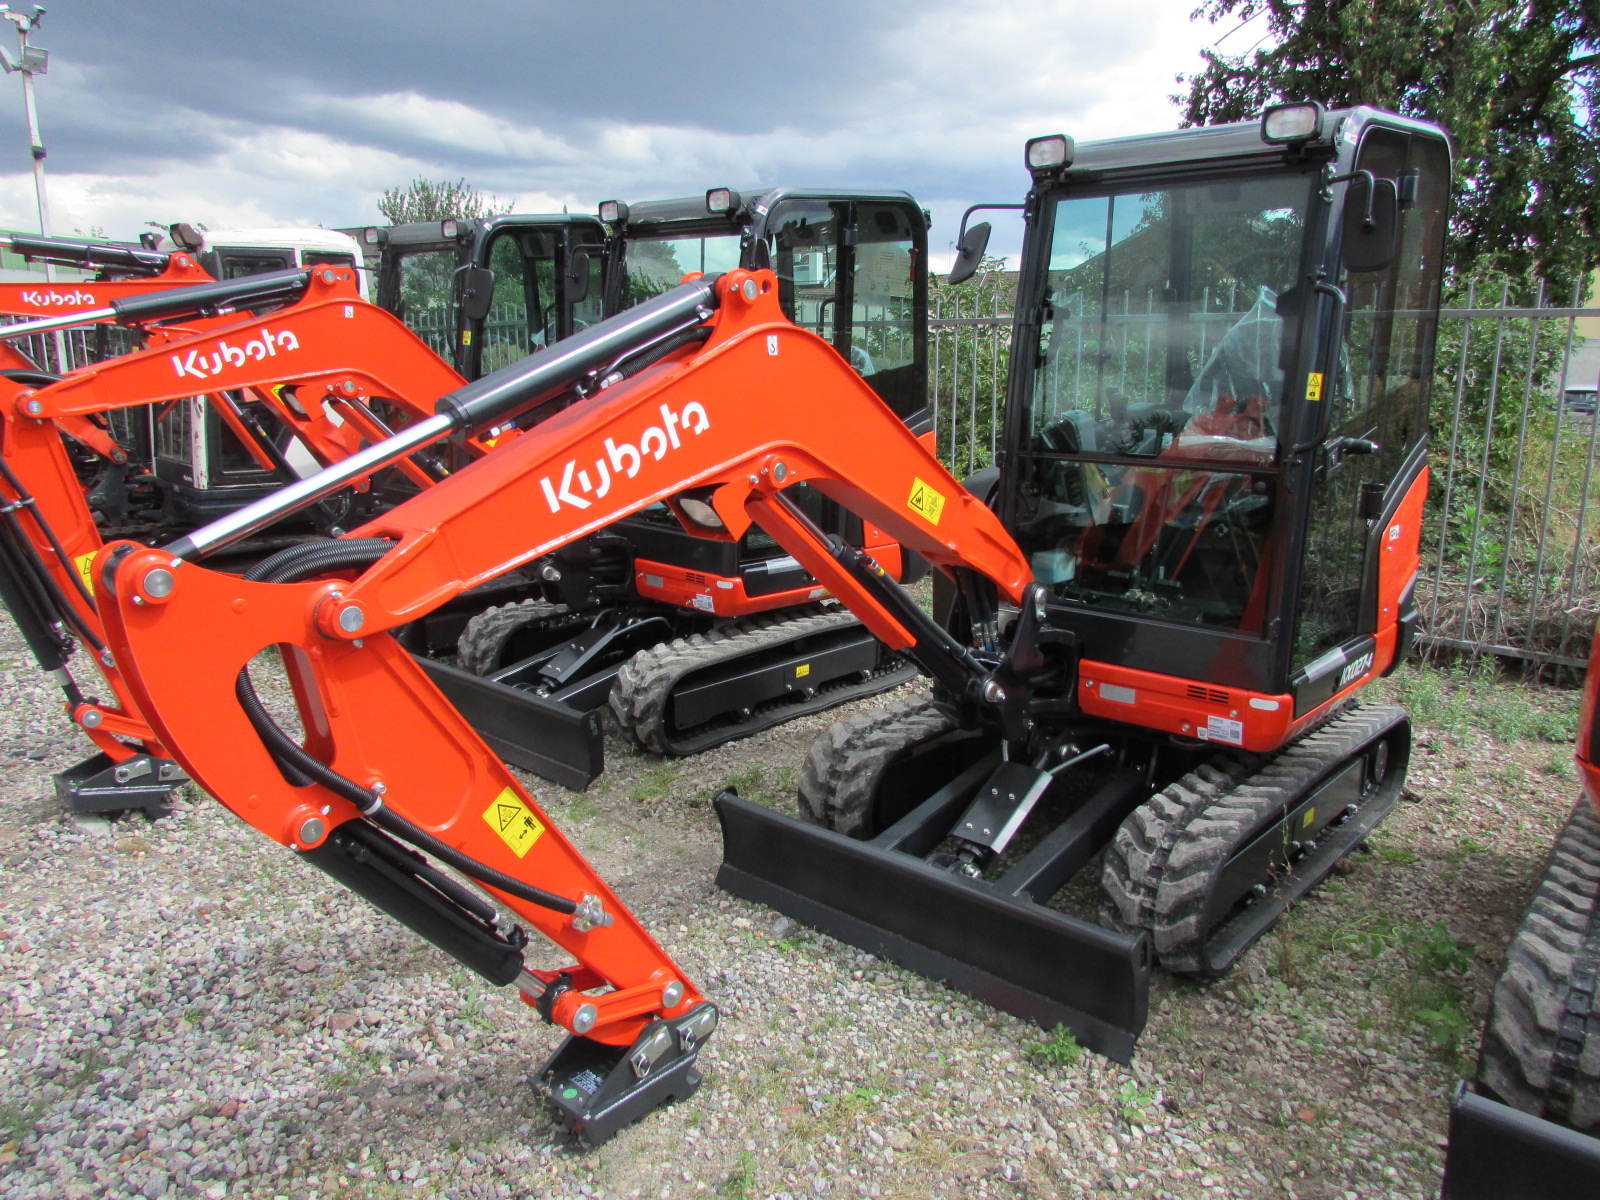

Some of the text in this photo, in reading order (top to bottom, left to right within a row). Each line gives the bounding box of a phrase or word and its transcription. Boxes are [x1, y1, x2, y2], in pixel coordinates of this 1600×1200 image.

[23, 291, 96, 307] Kubota
[172, 329, 299, 379] Kubota
[540, 401, 710, 514] Kubota
